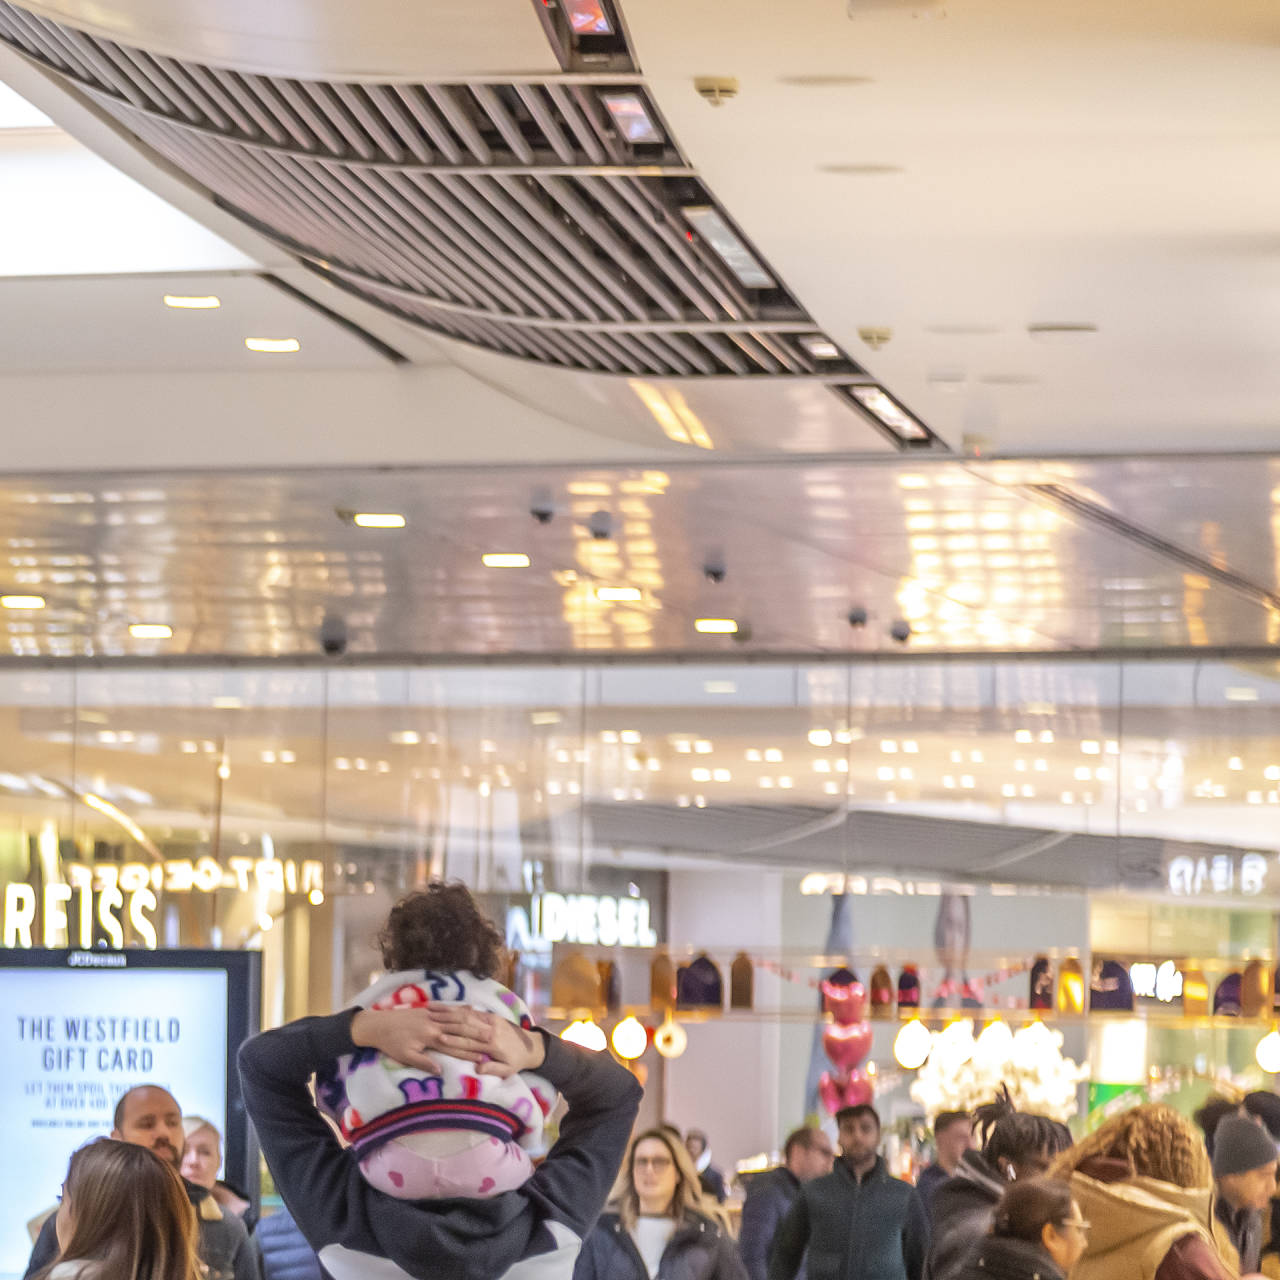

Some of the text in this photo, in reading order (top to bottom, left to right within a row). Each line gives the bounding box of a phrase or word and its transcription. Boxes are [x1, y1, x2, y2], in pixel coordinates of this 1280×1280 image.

[3, 882, 158, 950] REISS
[542, 892, 657, 948] DIESEL
[17, 1016, 181, 1043] THE WESTFIELD
[42, 1047, 153, 1072] GIFT CARD
